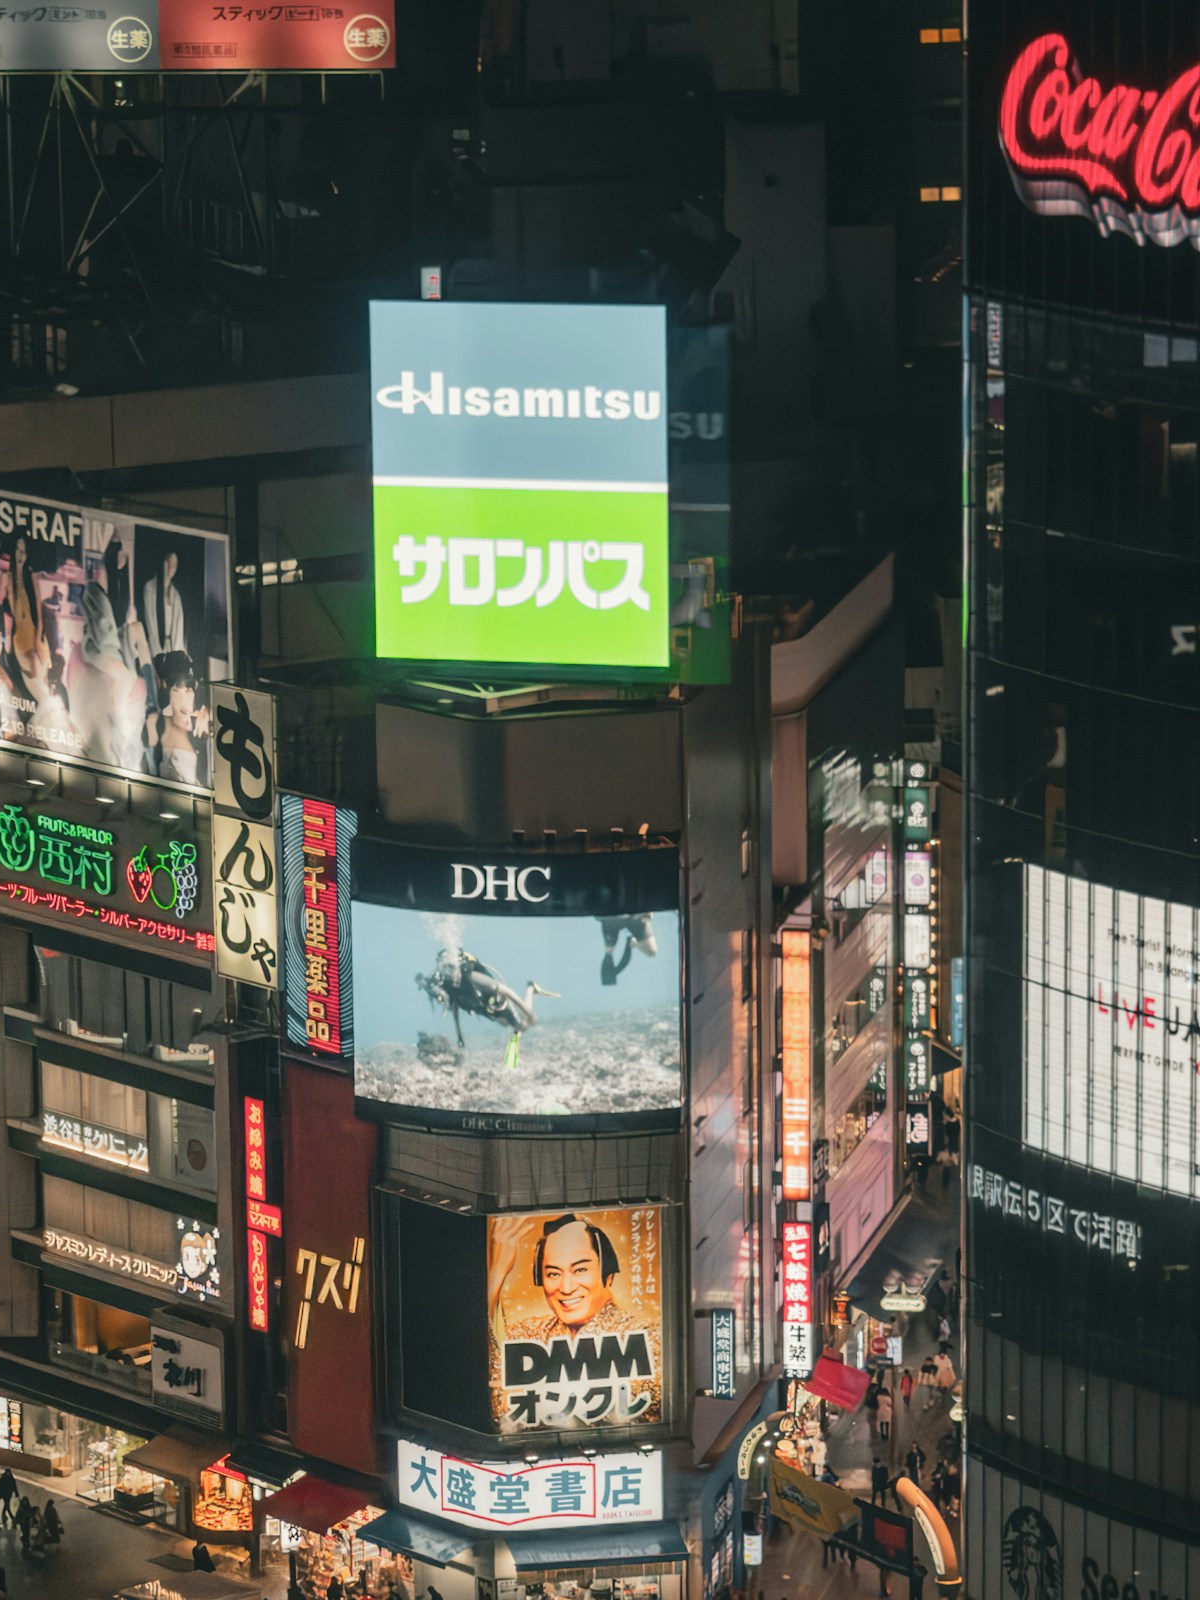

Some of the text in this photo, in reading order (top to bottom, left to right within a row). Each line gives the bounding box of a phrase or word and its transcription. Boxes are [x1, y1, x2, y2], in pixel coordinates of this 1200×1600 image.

[213, 5, 282, 22] スティック
[348, 28, 388, 49] 生薬
[111, 29, 148, 50] 生薬
[376, 371, 661, 420] Hisamitsu
[392, 534, 651, 611] サロンパス
[37, 814, 114, 846] FRUITS&PARLOR
[216, 691, 277, 983] もんじゃ
[38, 834, 114, 896] 西村
[451, 863, 551, 902] DHC
[302, 813, 330, 1042] 三千里薬品
[1097, 981, 1156, 1030] LIVE
[784, 1097, 808, 1190] 三千里
[504, 1333, 653, 1386] DMM
[715, 1314, 731, 1396] 大盛堂商事ビル
[507, 1382, 651, 1425] オンクレ
[410, 1455, 643, 1515] 大盛堂書店
